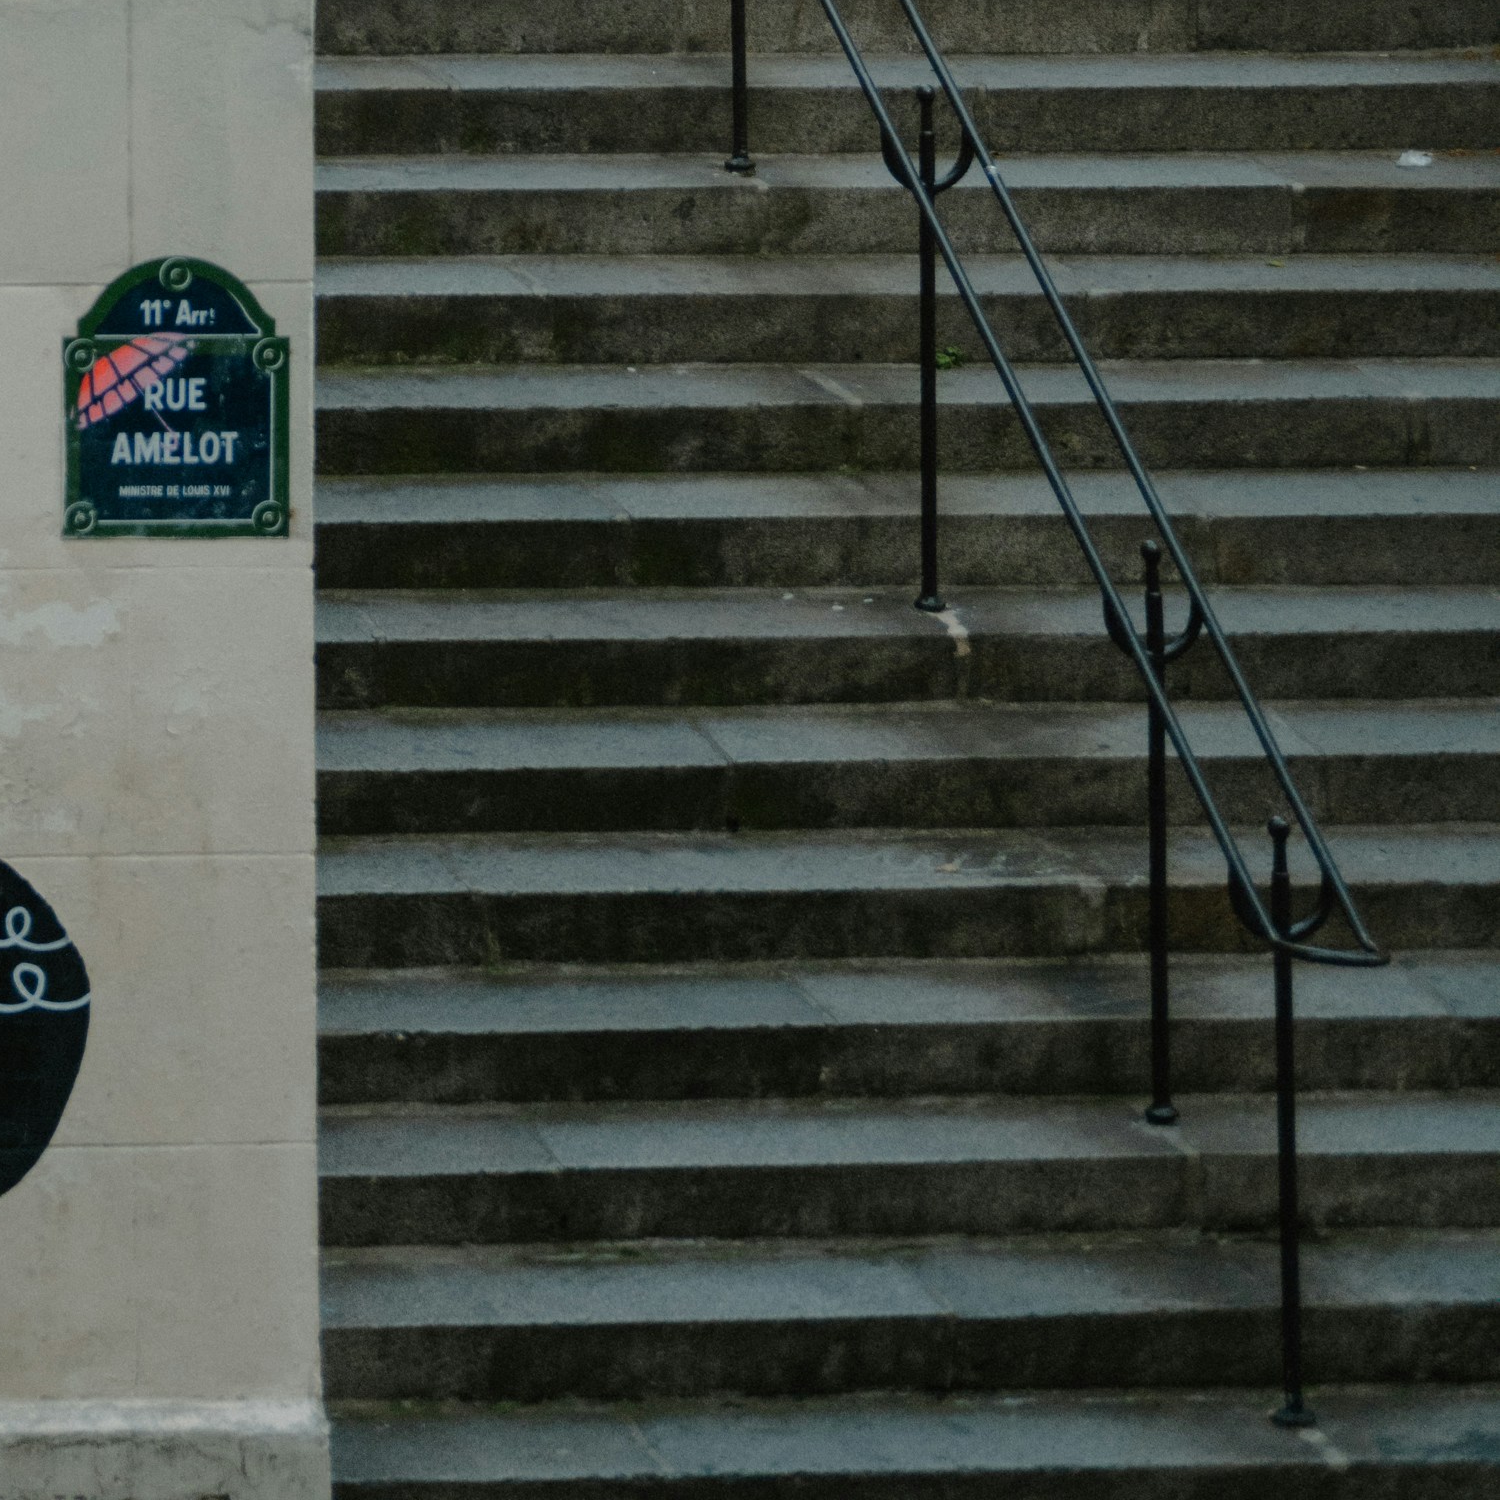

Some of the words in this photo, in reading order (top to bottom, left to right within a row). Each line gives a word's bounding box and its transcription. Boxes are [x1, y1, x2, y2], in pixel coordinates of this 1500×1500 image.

[144, 376, 207, 411] RUE
[110, 431, 238, 464] AMELOT
[119, 485, 164, 497] MINISTRE
[166, 485, 179, 497] DE
[182, 485, 210, 497] LOUIS
[213, 485, 230, 497] XVI
